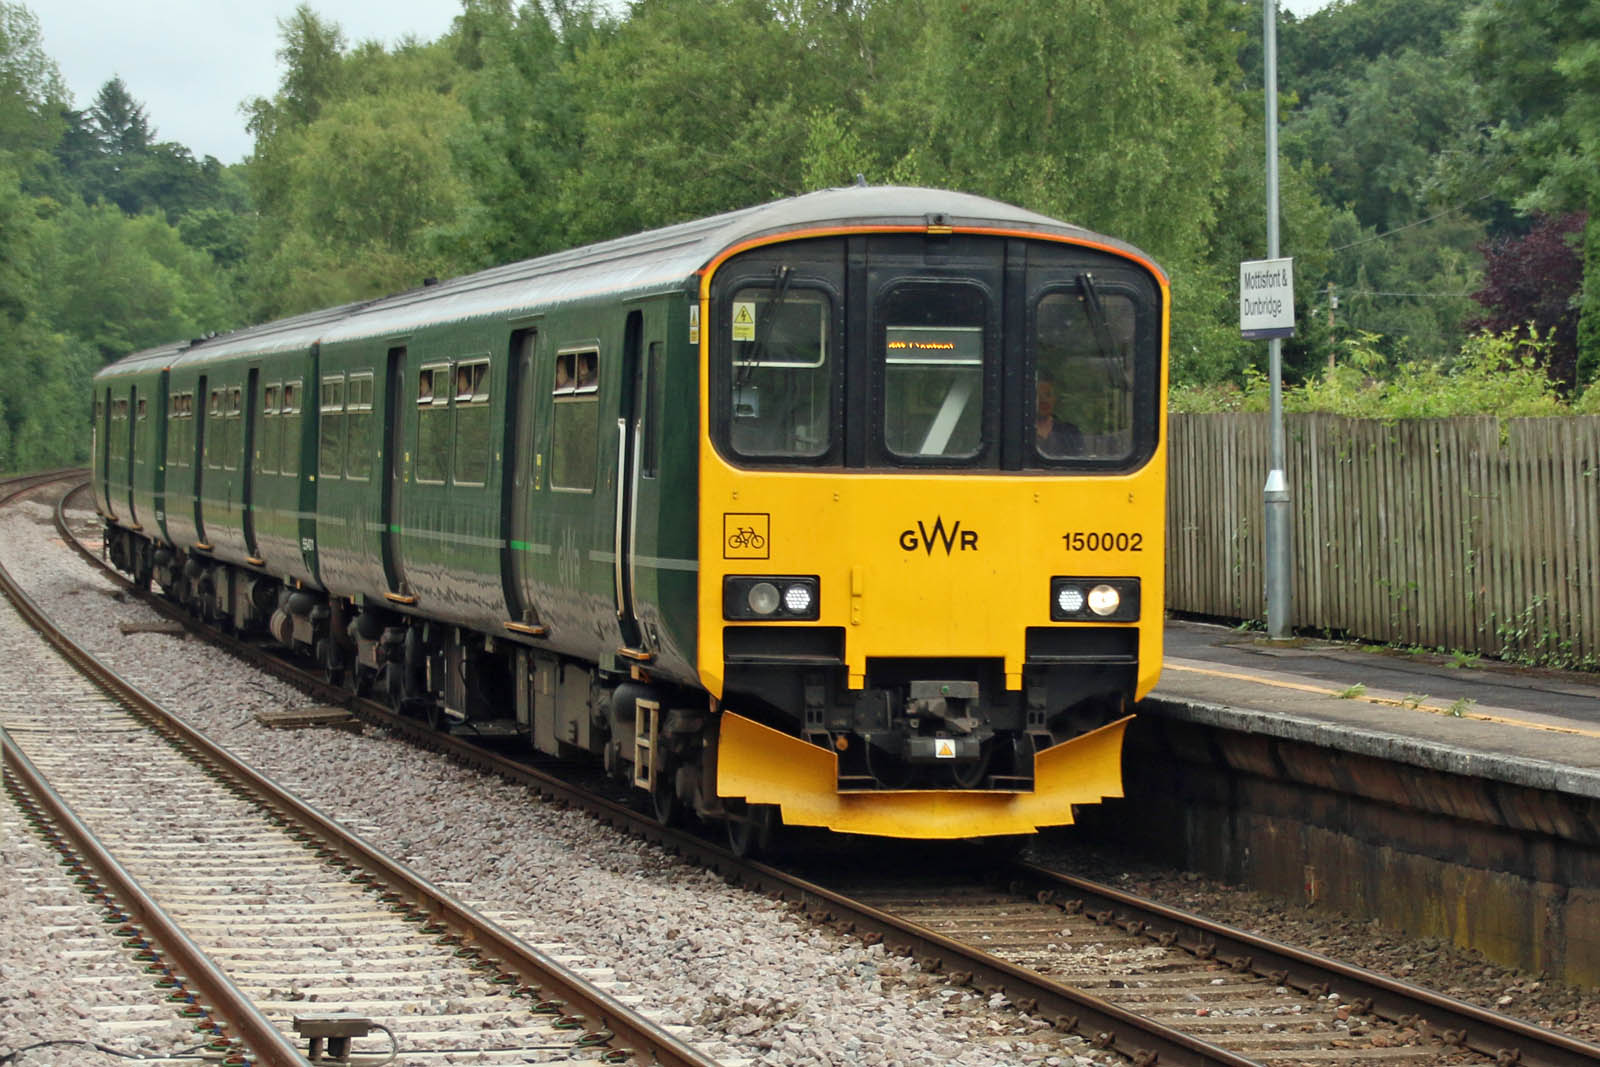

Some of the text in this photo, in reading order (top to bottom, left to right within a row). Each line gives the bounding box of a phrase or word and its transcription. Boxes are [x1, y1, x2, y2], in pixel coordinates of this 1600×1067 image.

[1244, 268, 1288, 291] Mottisfont &
[1244, 296, 1282, 318] Dunbridge
[899, 514, 979, 557] GWR
[1061, 532, 1143, 552] 150002
